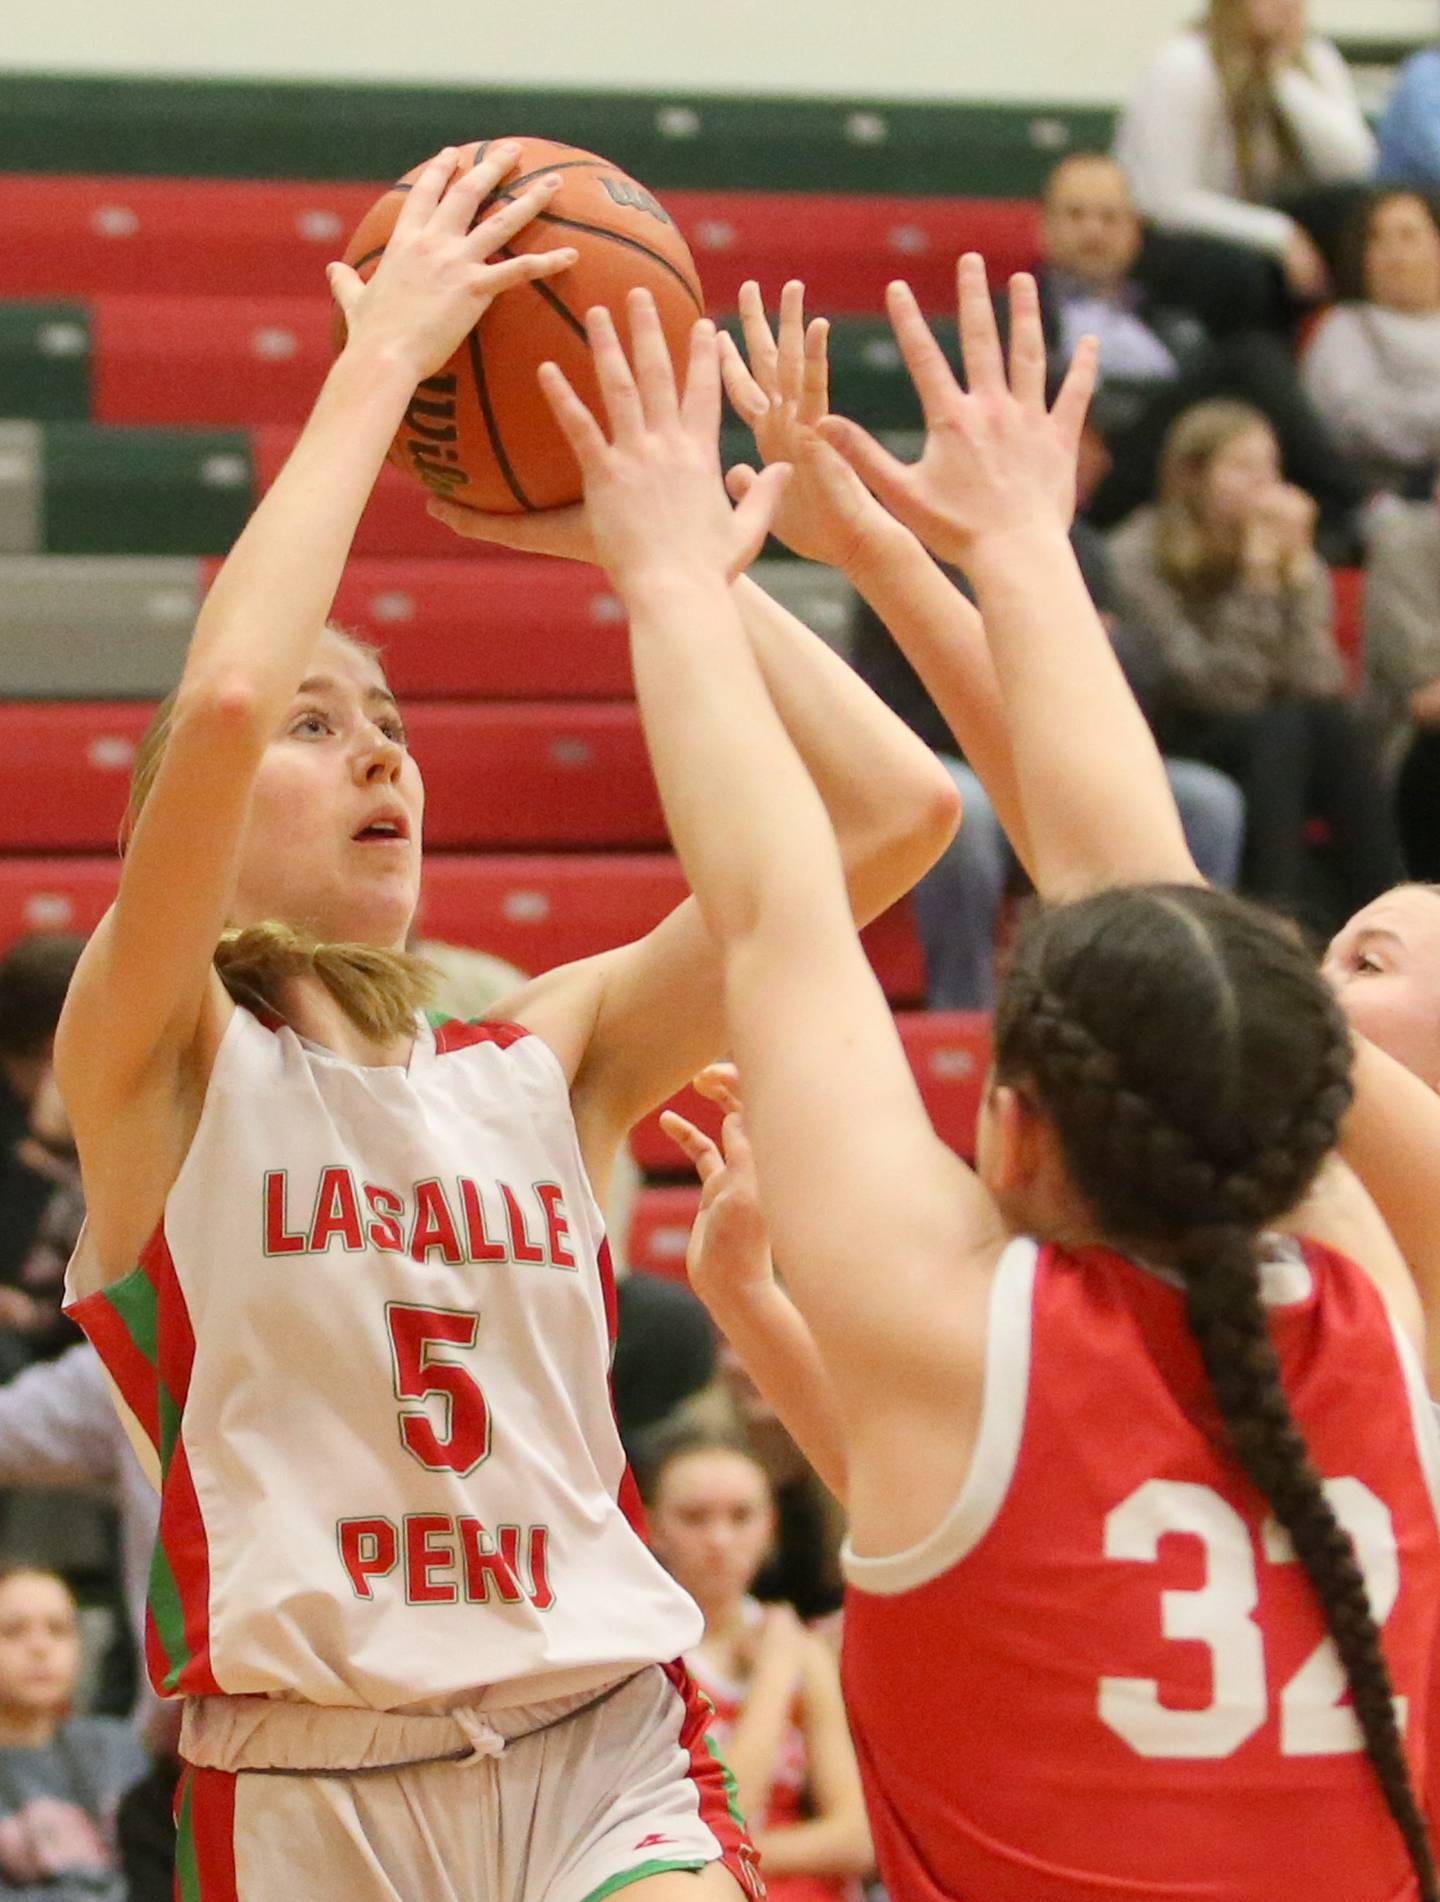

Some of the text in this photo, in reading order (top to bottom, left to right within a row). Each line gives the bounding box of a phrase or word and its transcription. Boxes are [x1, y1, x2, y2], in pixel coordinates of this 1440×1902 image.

[263, 1165, 579, 1272] LASALLE
[385, 1301, 492, 1478] 5
[336, 1512, 557, 1613] PERU
[1098, 1476, 1408, 1759] 32
